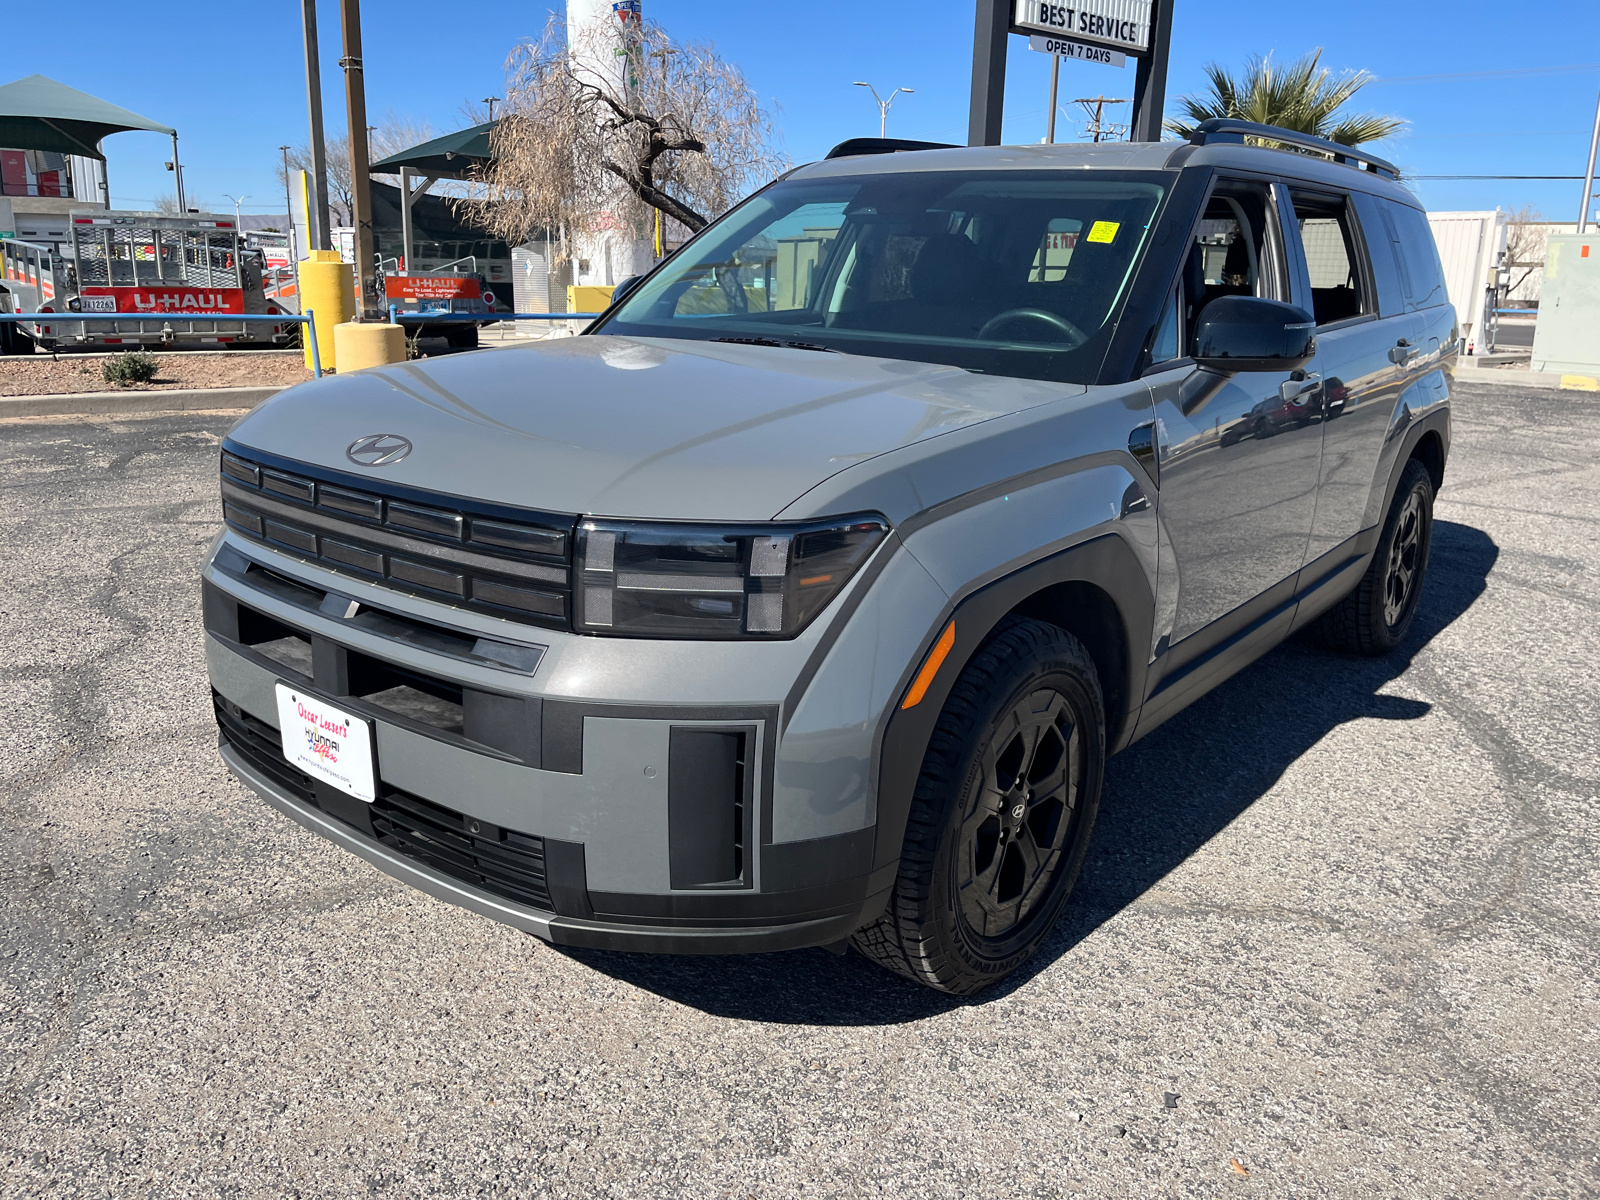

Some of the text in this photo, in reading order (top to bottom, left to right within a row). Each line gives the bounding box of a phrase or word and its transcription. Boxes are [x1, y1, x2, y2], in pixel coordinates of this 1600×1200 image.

[1040, 3, 1137, 42] BEST SERVICE
[1046, 40, 1111, 63] OPEN 7 DAYS
[408, 279, 458, 288] U-HAUL
[134, 293, 230, 308] U-HAUL
[297, 702, 347, 738] Oscar Leeser's
[305, 727, 340, 752] HYUNDAI
